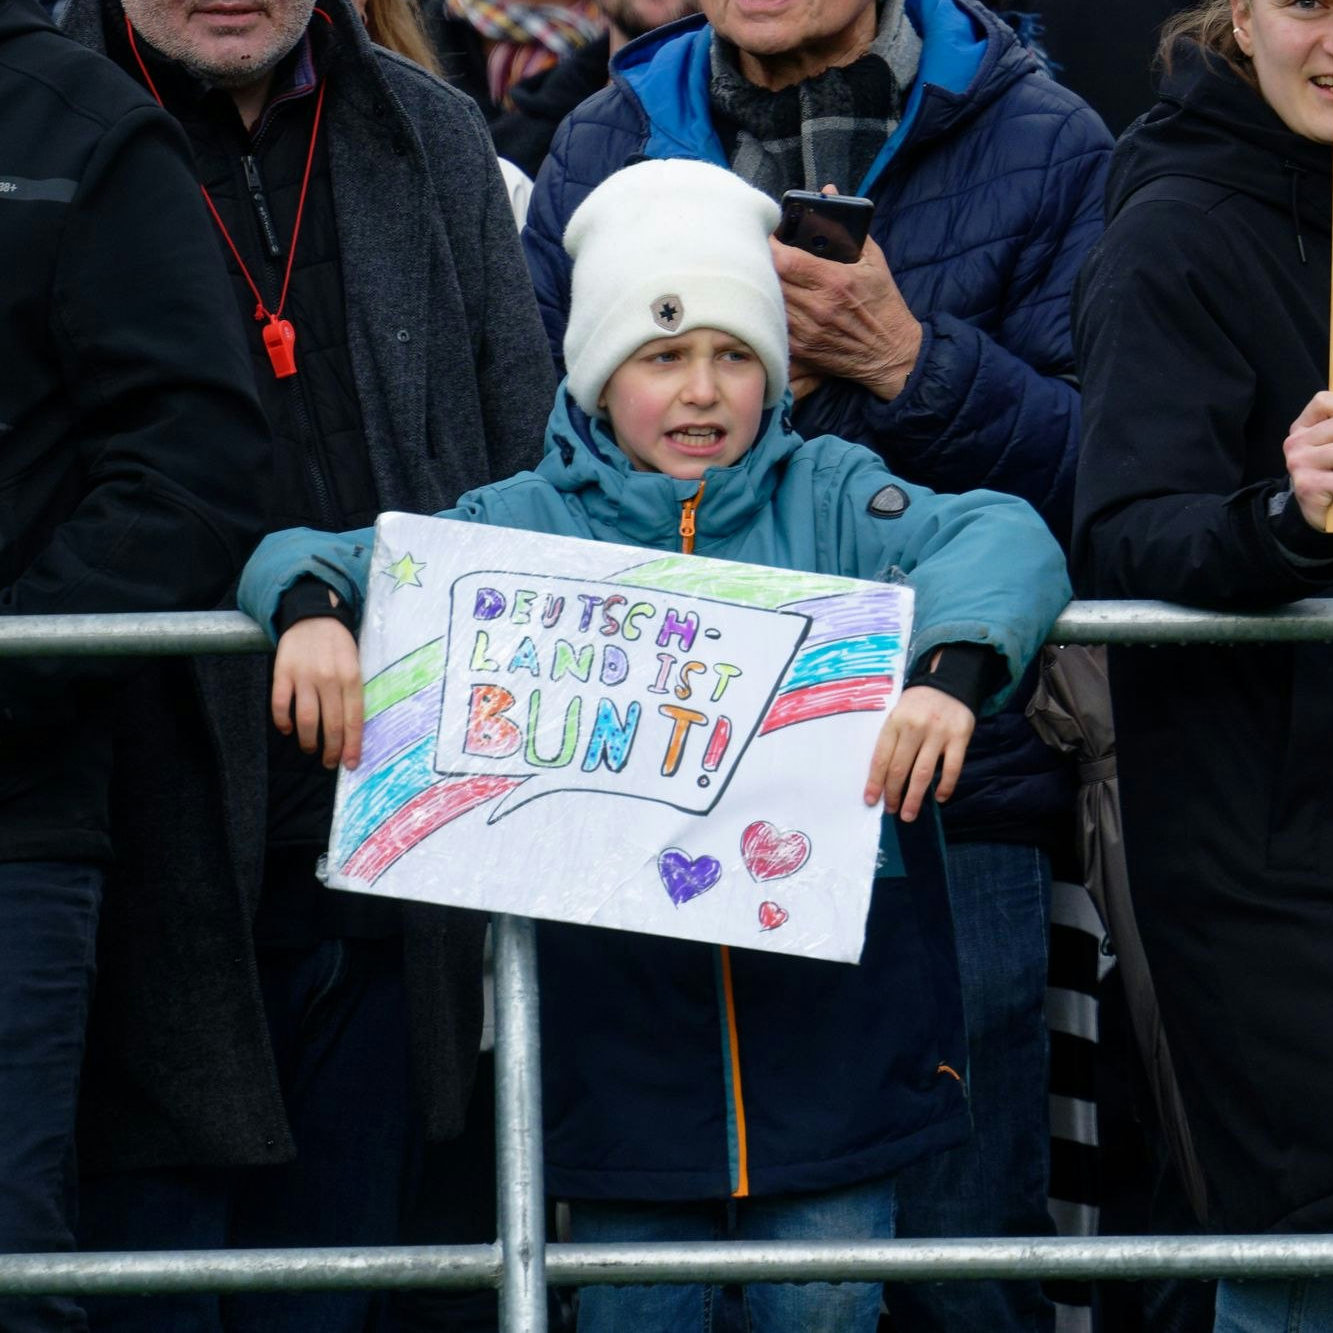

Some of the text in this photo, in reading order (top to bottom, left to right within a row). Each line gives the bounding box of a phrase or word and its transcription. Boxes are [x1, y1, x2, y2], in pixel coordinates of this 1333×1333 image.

[471, 587, 723, 654] DEUTSCH-
[469, 631, 744, 702] LAND IST
[462, 682, 731, 790] BUNT!
